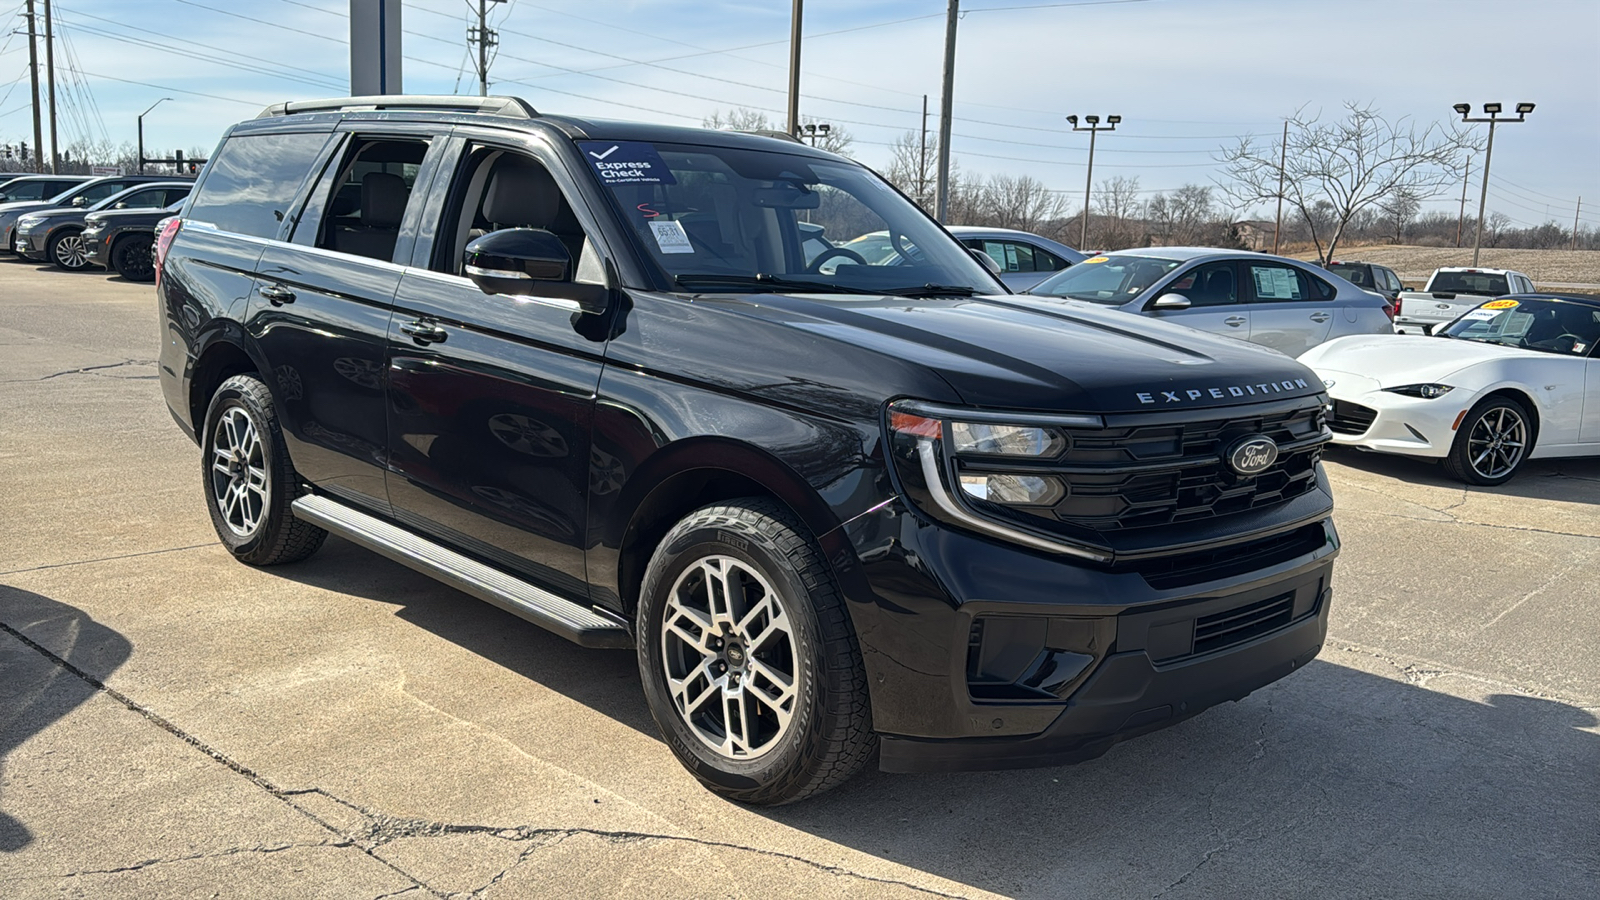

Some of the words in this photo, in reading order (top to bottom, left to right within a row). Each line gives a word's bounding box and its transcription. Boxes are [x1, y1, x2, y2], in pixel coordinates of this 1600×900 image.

[595, 161, 651, 170] Express
[601, 169, 644, 178] Check
[1136, 378, 1308, 404] EXPEDITION
[1241, 444, 1271, 467] Ford
[717, 530, 749, 551] PIRELLI
[641, 576, 656, 660] PIRELLI
[793, 622, 813, 751] SCORPION
